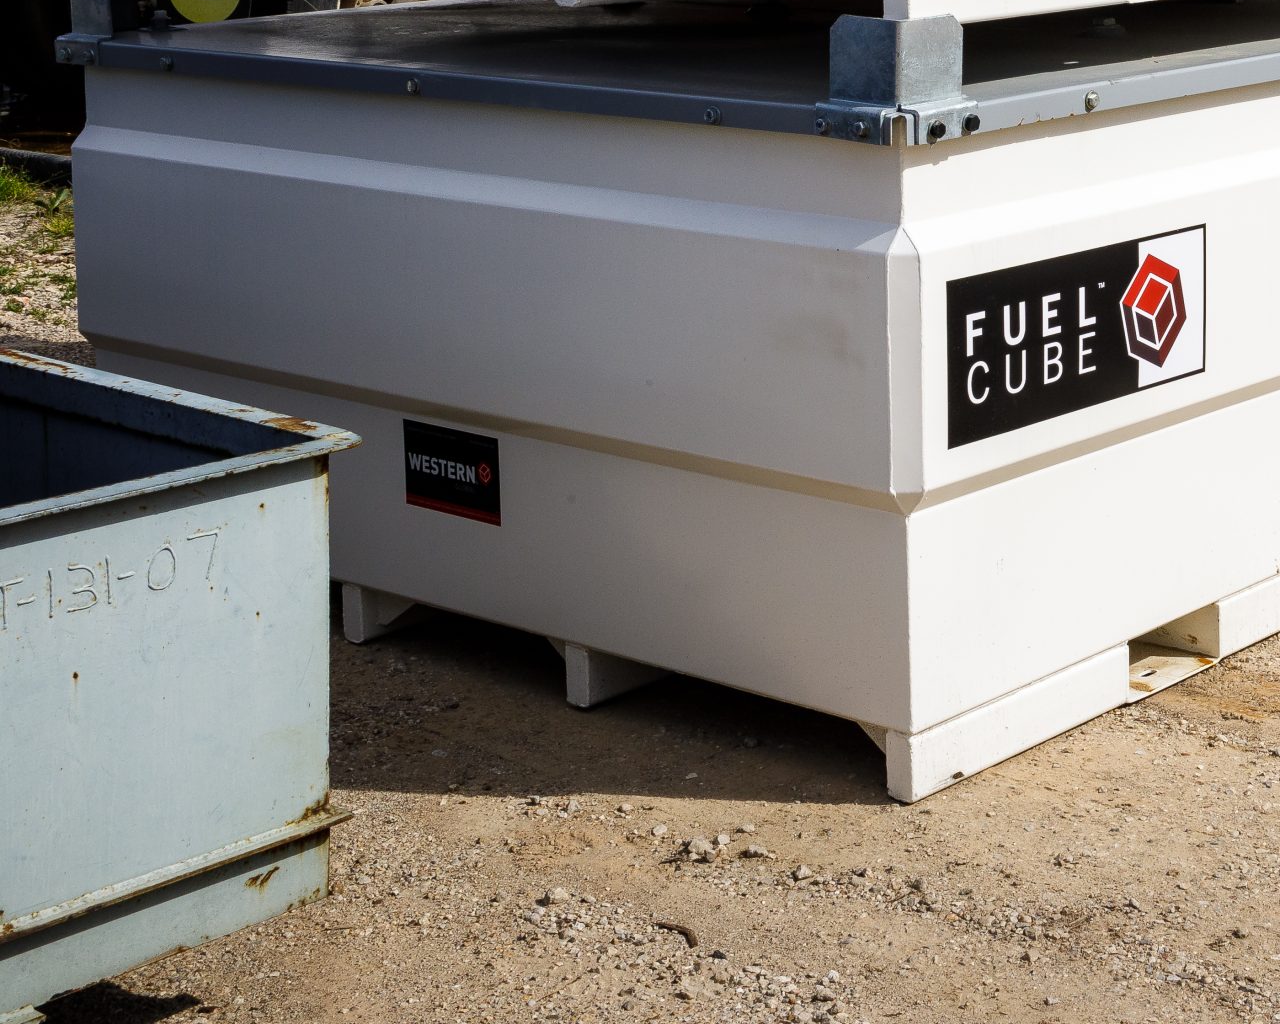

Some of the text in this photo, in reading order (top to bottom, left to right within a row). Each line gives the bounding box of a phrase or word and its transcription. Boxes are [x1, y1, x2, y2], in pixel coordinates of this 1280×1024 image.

[965, 286, 1097, 358] FUEL
[967, 331, 1097, 405] CUBE
[408, 451, 477, 485] WESTERN
